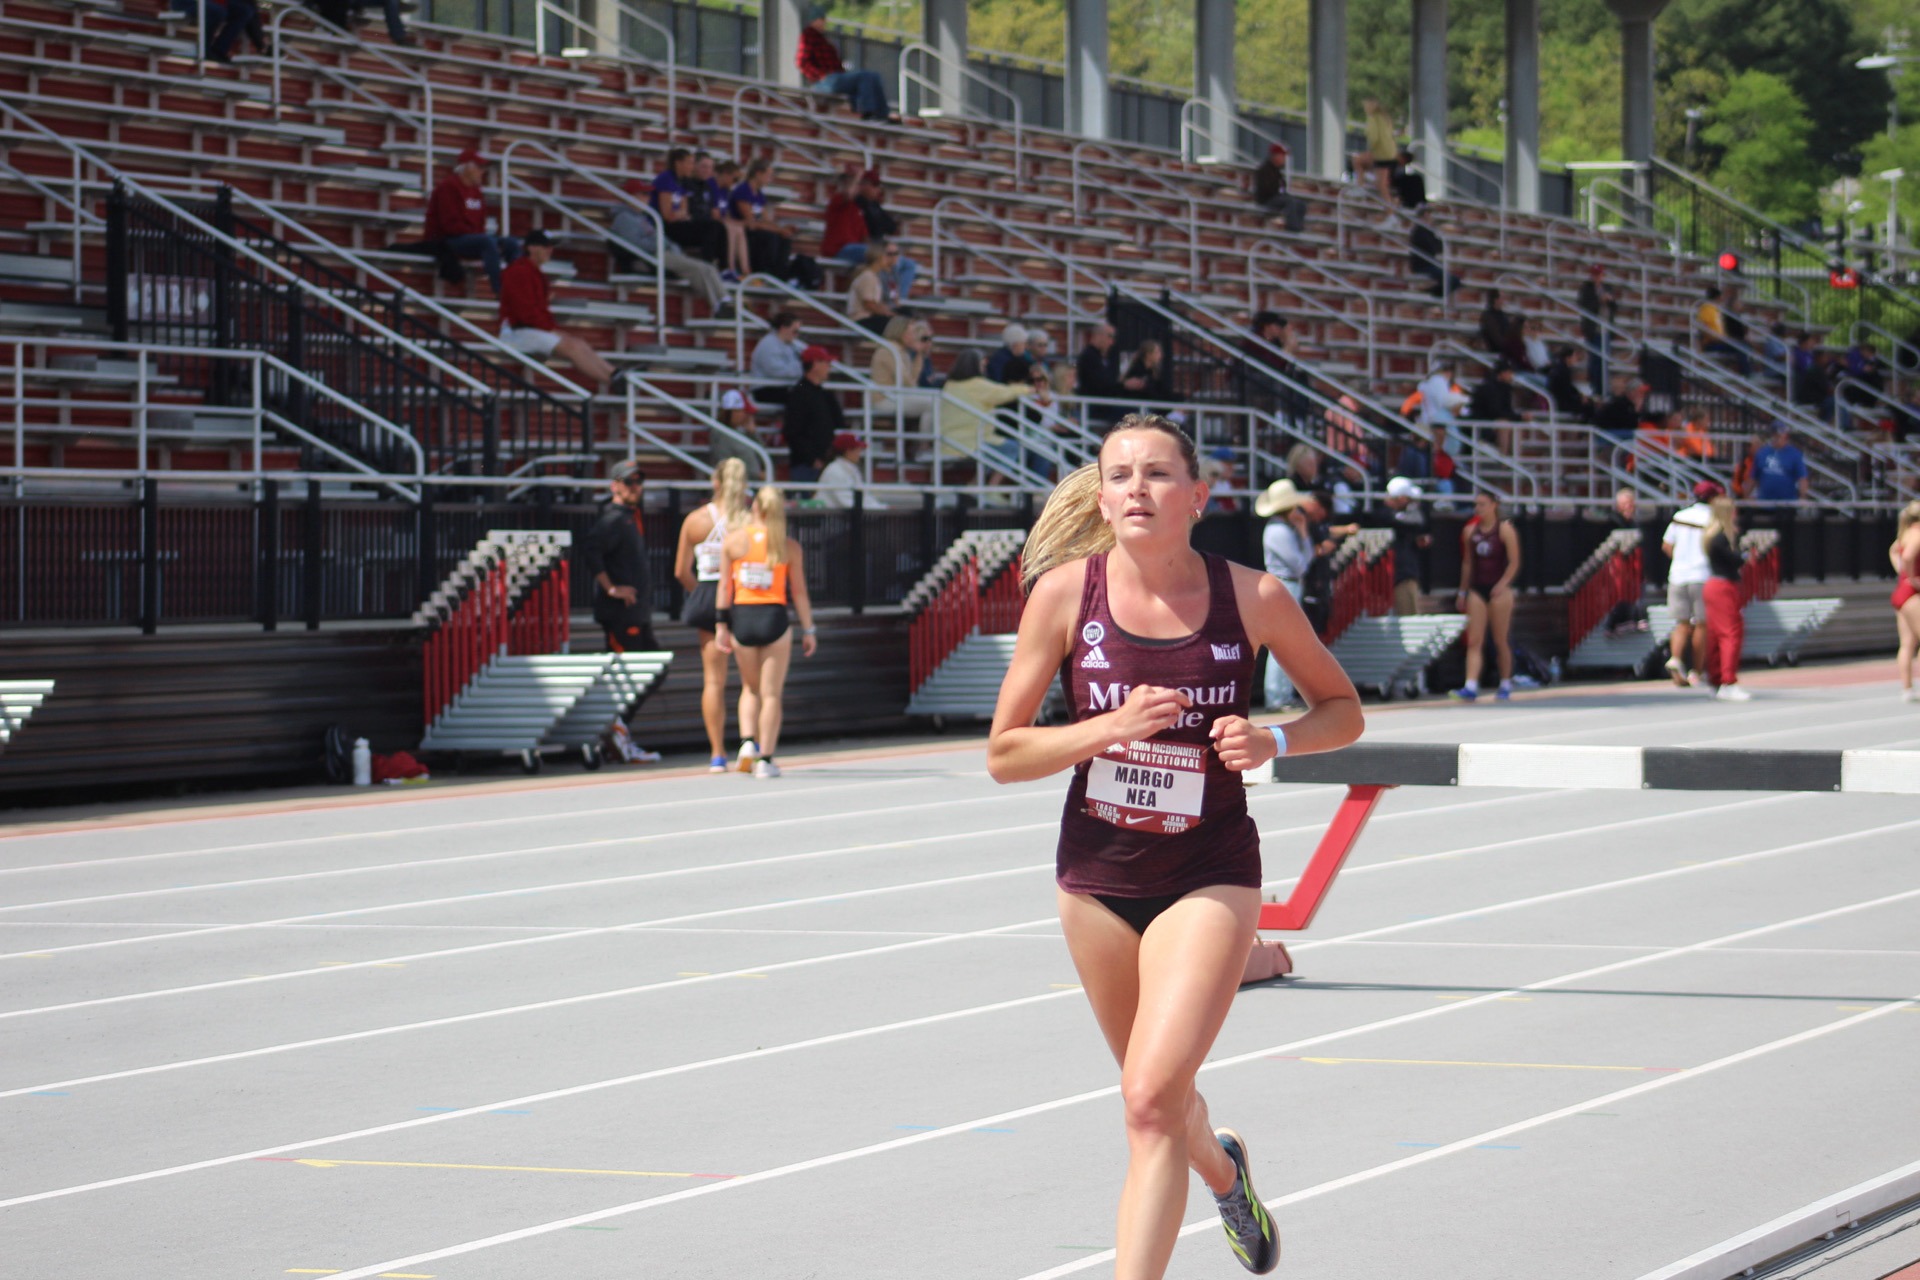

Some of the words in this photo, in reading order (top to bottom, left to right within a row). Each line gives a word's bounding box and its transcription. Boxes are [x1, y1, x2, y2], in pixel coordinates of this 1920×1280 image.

[1210, 643, 1240, 660] VALLEY
[1081, 659, 1110, 669] adidas
[1088, 680, 1236, 710] Miouri
[1129, 740, 1151, 752] JOHN
[1152, 743, 1201, 758] MCDONNELL
[1128, 750, 1200, 769] INVITATIONAL
[1114, 766, 1174, 790] MARGO
[1126, 787, 1157, 808] NEA
[1167, 815, 1186, 823] JOHN
